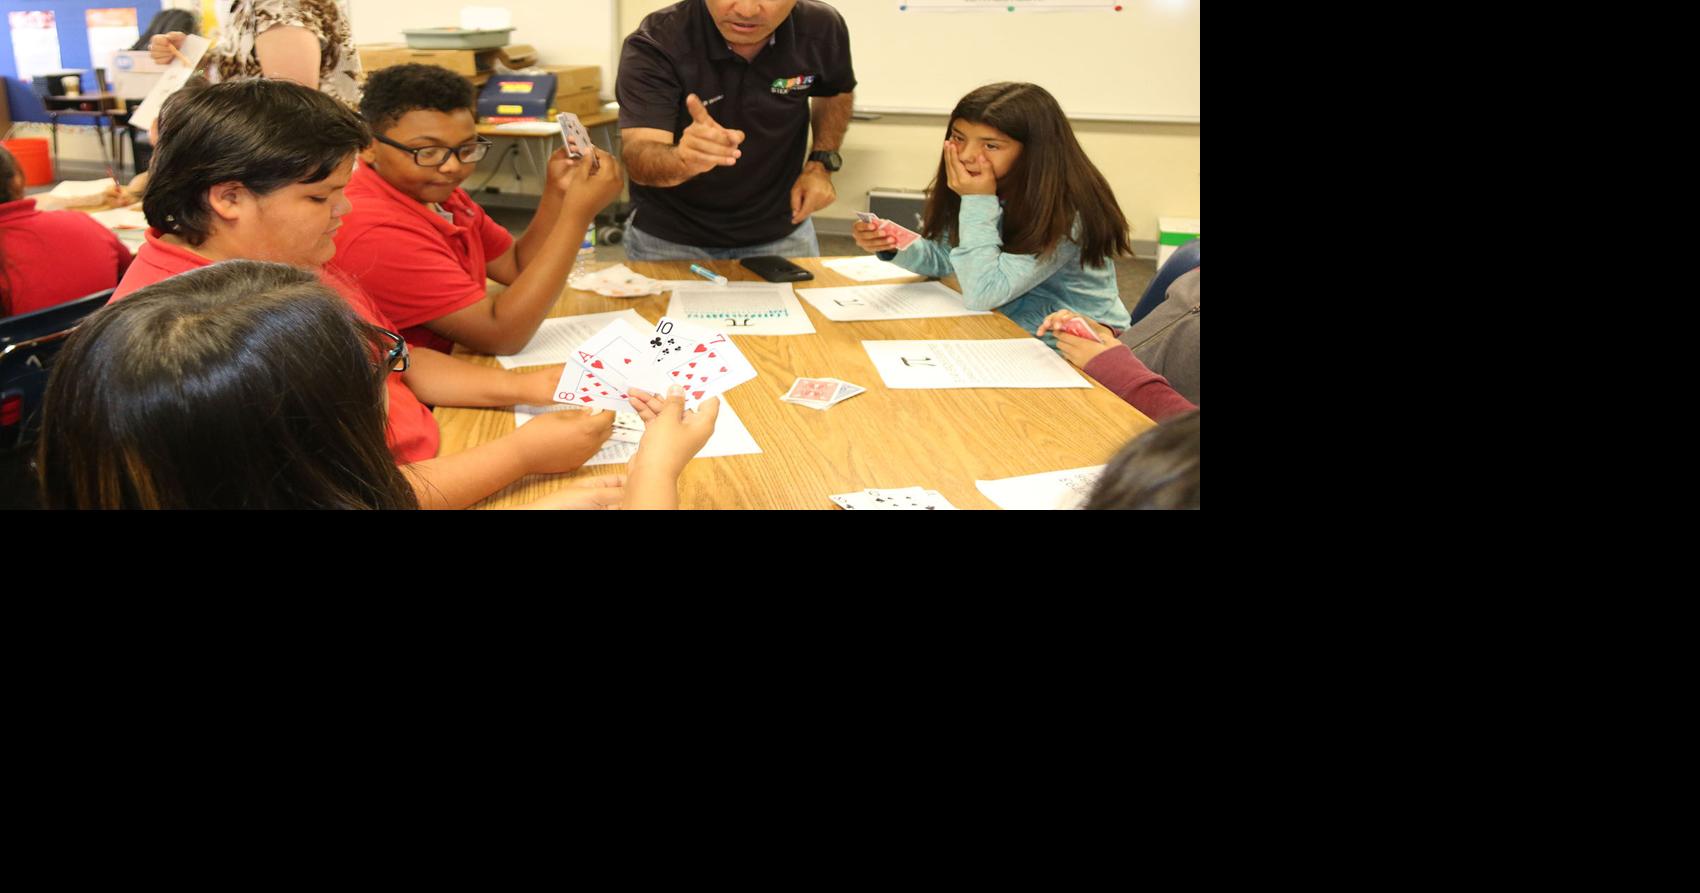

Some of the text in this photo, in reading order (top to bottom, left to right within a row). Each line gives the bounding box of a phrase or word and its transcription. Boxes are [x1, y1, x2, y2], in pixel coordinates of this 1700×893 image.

[655, 320, 674, 335] 10
[709, 333, 727, 345] 7
[578, 350, 594, 363] A
[558, 391, 575, 401] 8
